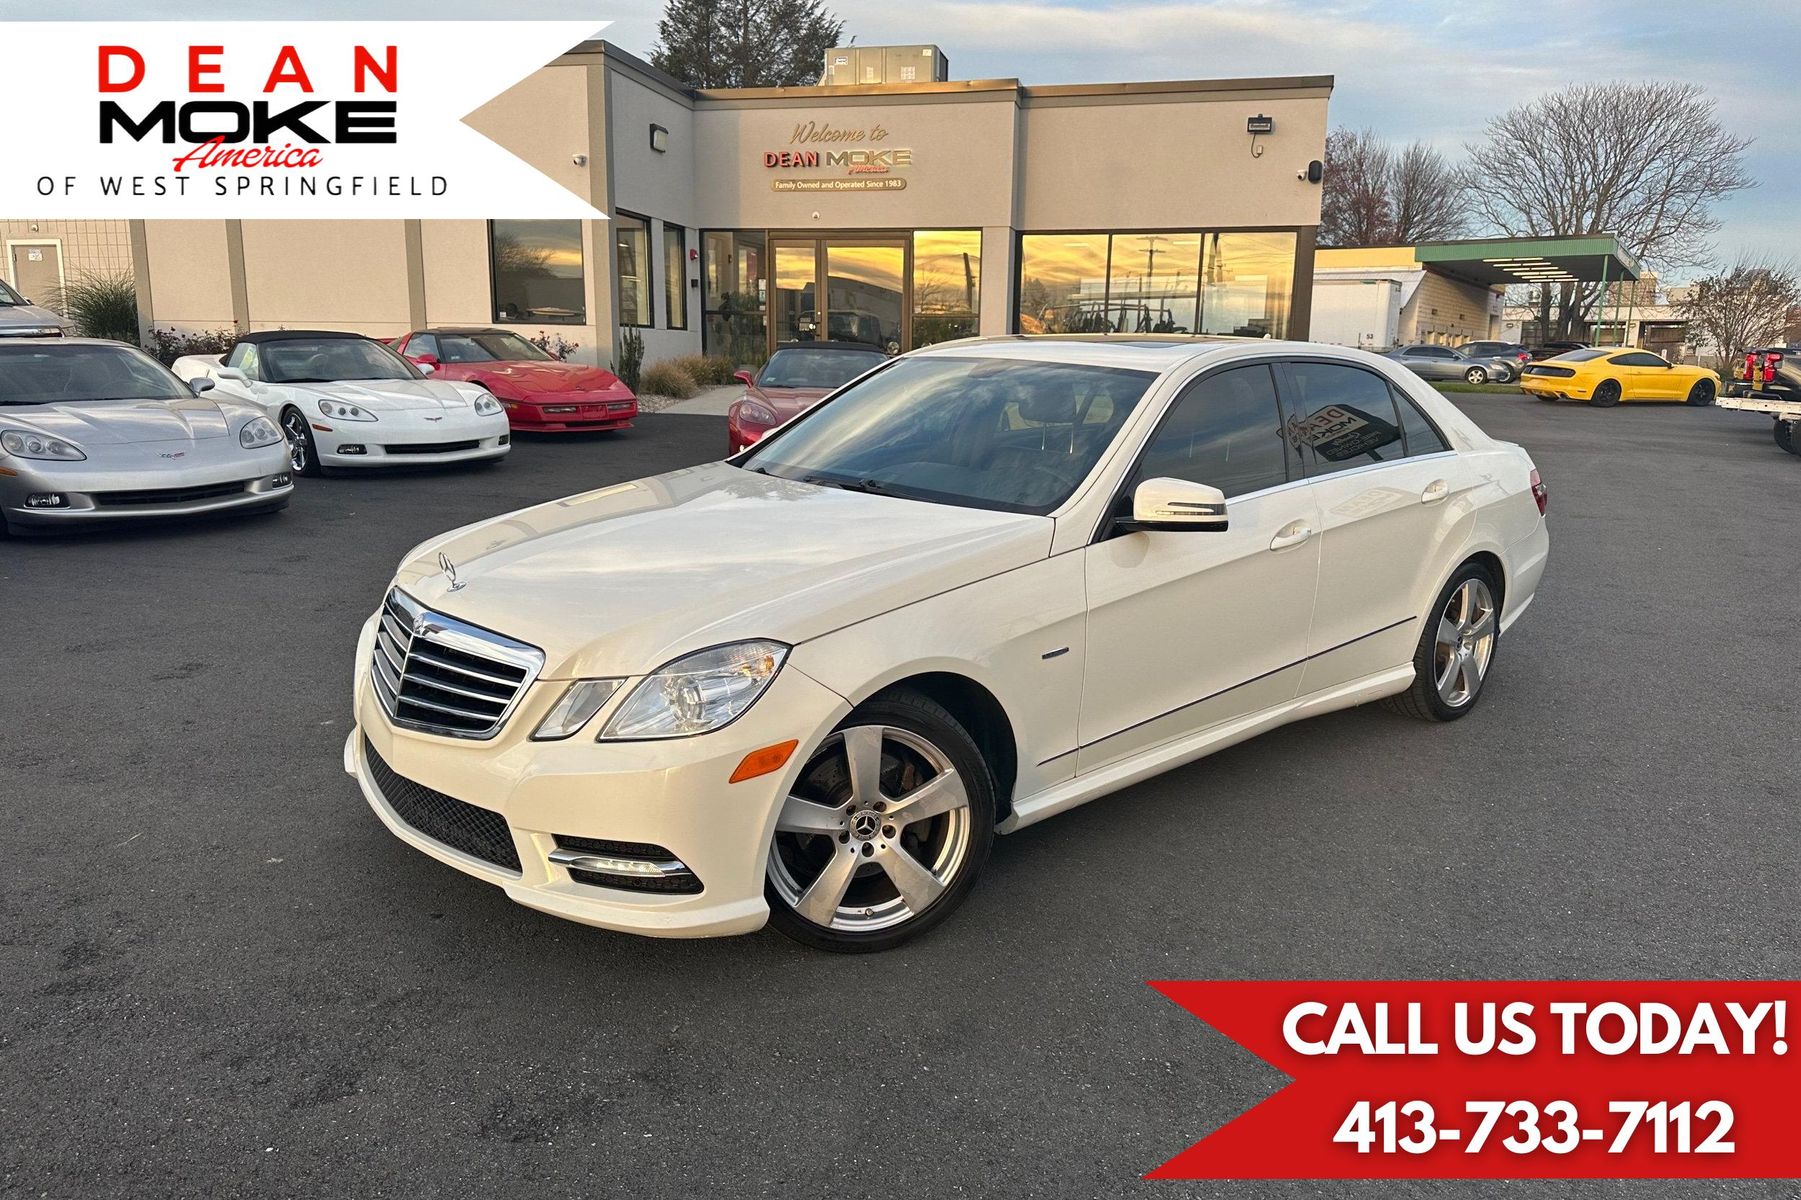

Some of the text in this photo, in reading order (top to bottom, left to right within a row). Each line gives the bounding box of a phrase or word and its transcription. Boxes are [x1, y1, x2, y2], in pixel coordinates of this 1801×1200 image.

[790, 121, 888, 144] Welcome to
[764, 150, 912, 168] DEAN MOKE
[775, 181, 796, 190] Family
[821, 180, 834, 188] and
[835, 180, 865, 189] Operated
[866, 180, 884, 188] Since
[885, 179, 902, 187] 1983
